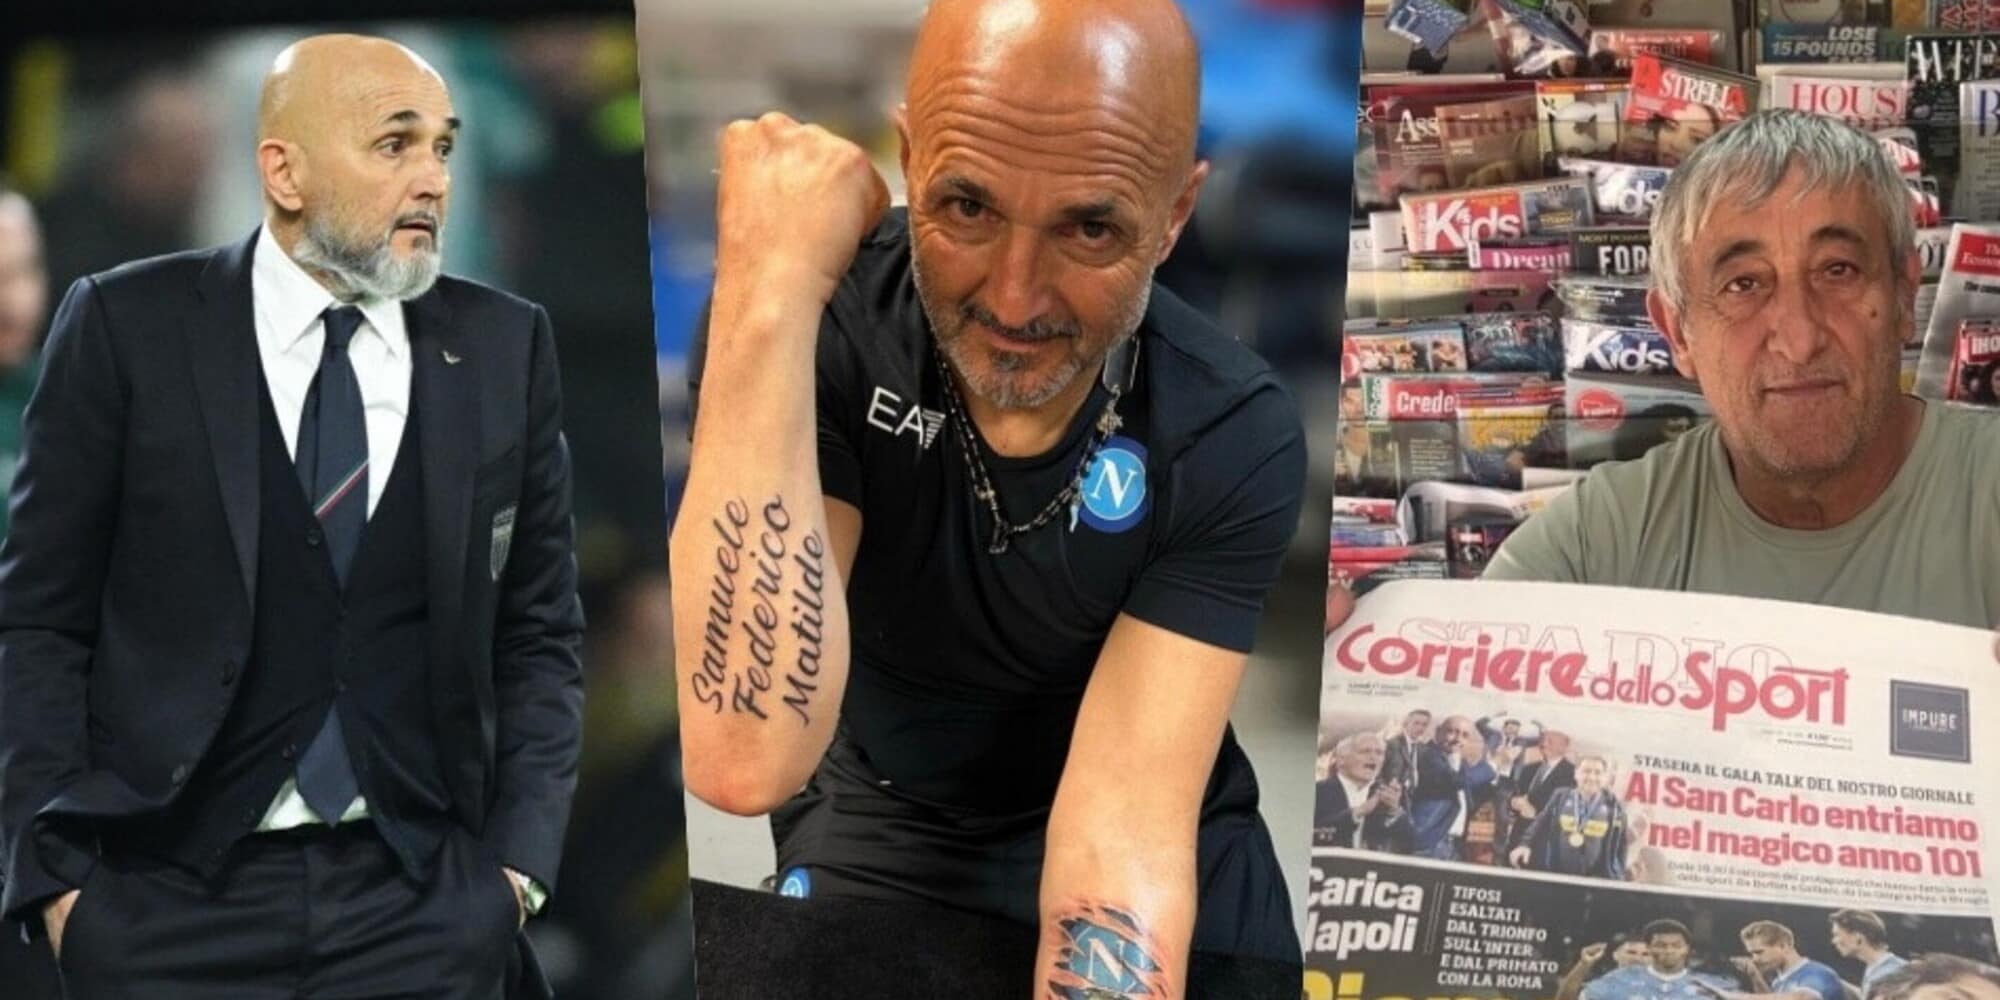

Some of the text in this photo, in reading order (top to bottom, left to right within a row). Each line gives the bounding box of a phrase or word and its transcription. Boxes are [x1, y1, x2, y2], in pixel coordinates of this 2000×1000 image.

[1771, 41, 1876, 56] 15 POUNDS
[1828, 26, 1877, 41] LOSE
[1424, 199, 1522, 251] Kids
[1577, 324, 1670, 371] Kids
[1090, 459, 1138, 509] N
[692, 497, 749, 714] Samuele
[732, 494, 790, 720] Federico
[782, 527, 824, 728] Matilde
[1336, 623, 1850, 731] Corriere dello Sport
[1902, 708, 1958, 730] IMPURE
[1634, 754, 1976, 805] STASERA IL GALA TALK DEL NOSTRO GIORNALE
[1624, 771, 1980, 843] Al San Carlo entriamo
[1648, 819, 1983, 879] nel magico anno 101
[1449, 901, 1521, 923] ESALTATI
[1453, 885, 1501, 903] TIFOSI
[1446, 920, 1547, 941] DAL TRIONFO
[1087, 937, 1124, 981] N
[1437, 971, 1542, 989] CON LA ROMA
[1440, 953, 1558, 973] E DAL PRIMATO
